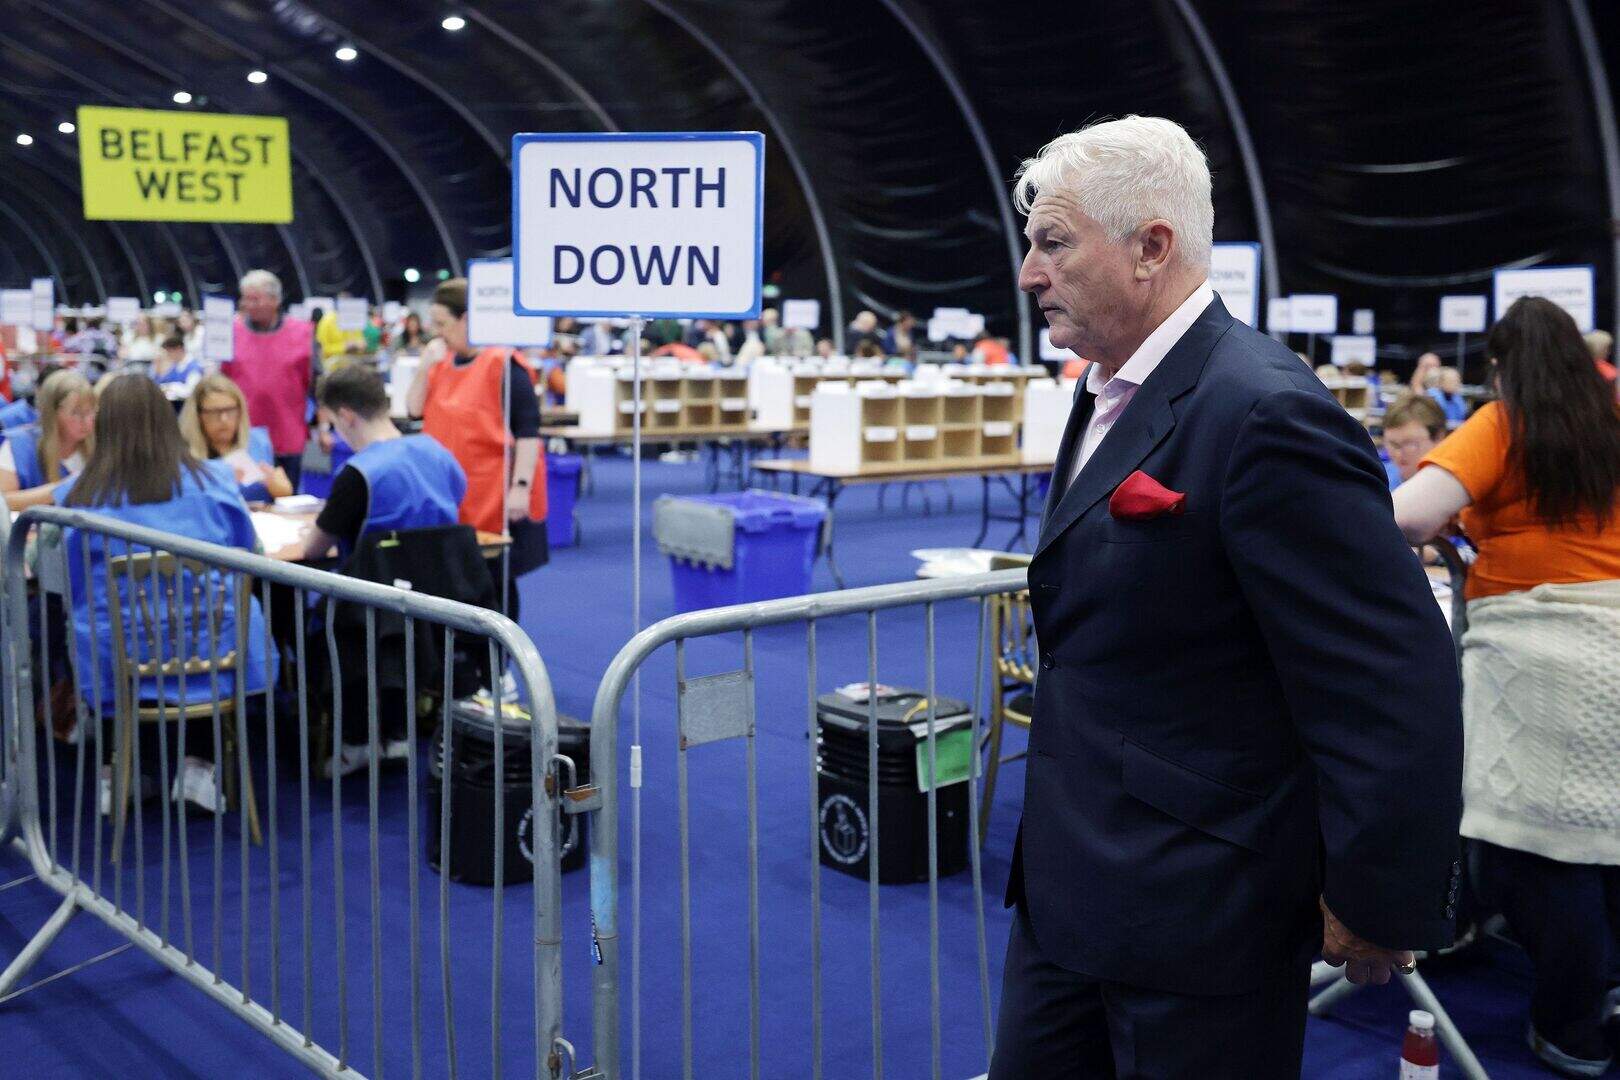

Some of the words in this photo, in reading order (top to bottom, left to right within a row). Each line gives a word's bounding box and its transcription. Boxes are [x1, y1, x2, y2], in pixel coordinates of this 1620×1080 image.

[100, 128, 274, 167] BELFAST
[135, 169, 245, 203] WEST
[550, 167, 726, 209] NORTH
[553, 244, 720, 286] DOWN
